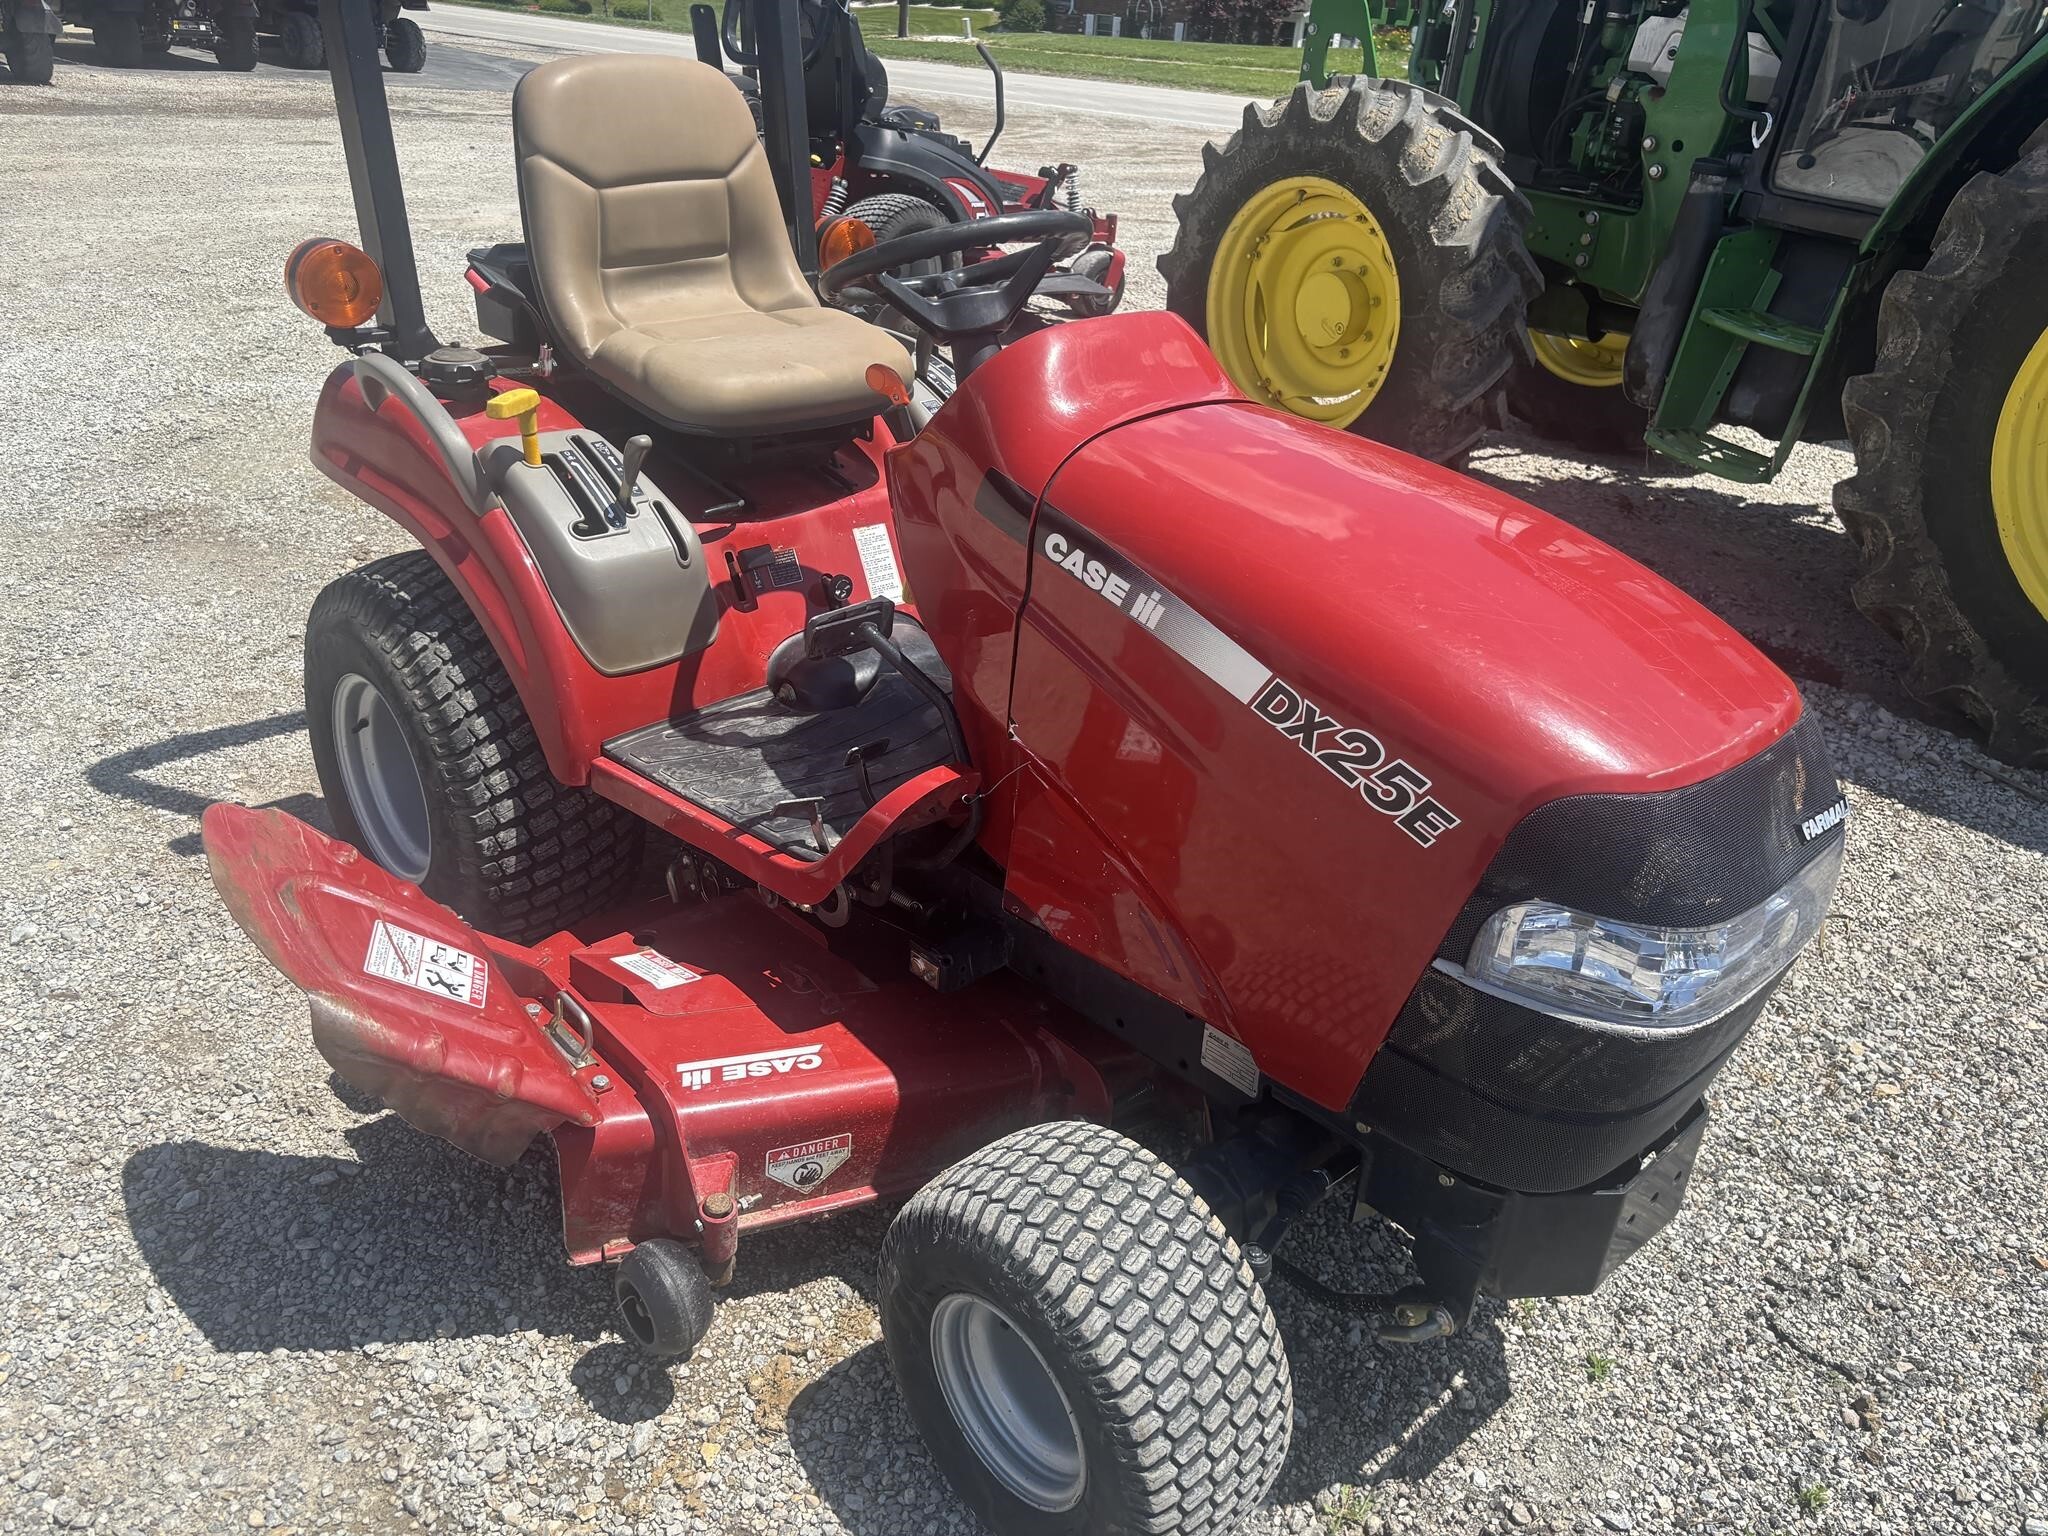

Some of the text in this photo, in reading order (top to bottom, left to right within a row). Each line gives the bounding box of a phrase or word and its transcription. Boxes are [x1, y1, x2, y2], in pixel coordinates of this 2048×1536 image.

[1044, 533, 1131, 607] CASE
[1251, 677, 1461, 849] DX25E
[471, 969, 486, 1001] DANGER
[722, 1053, 823, 1082] CASE
[792, 1139, 839, 1158] DANGER
